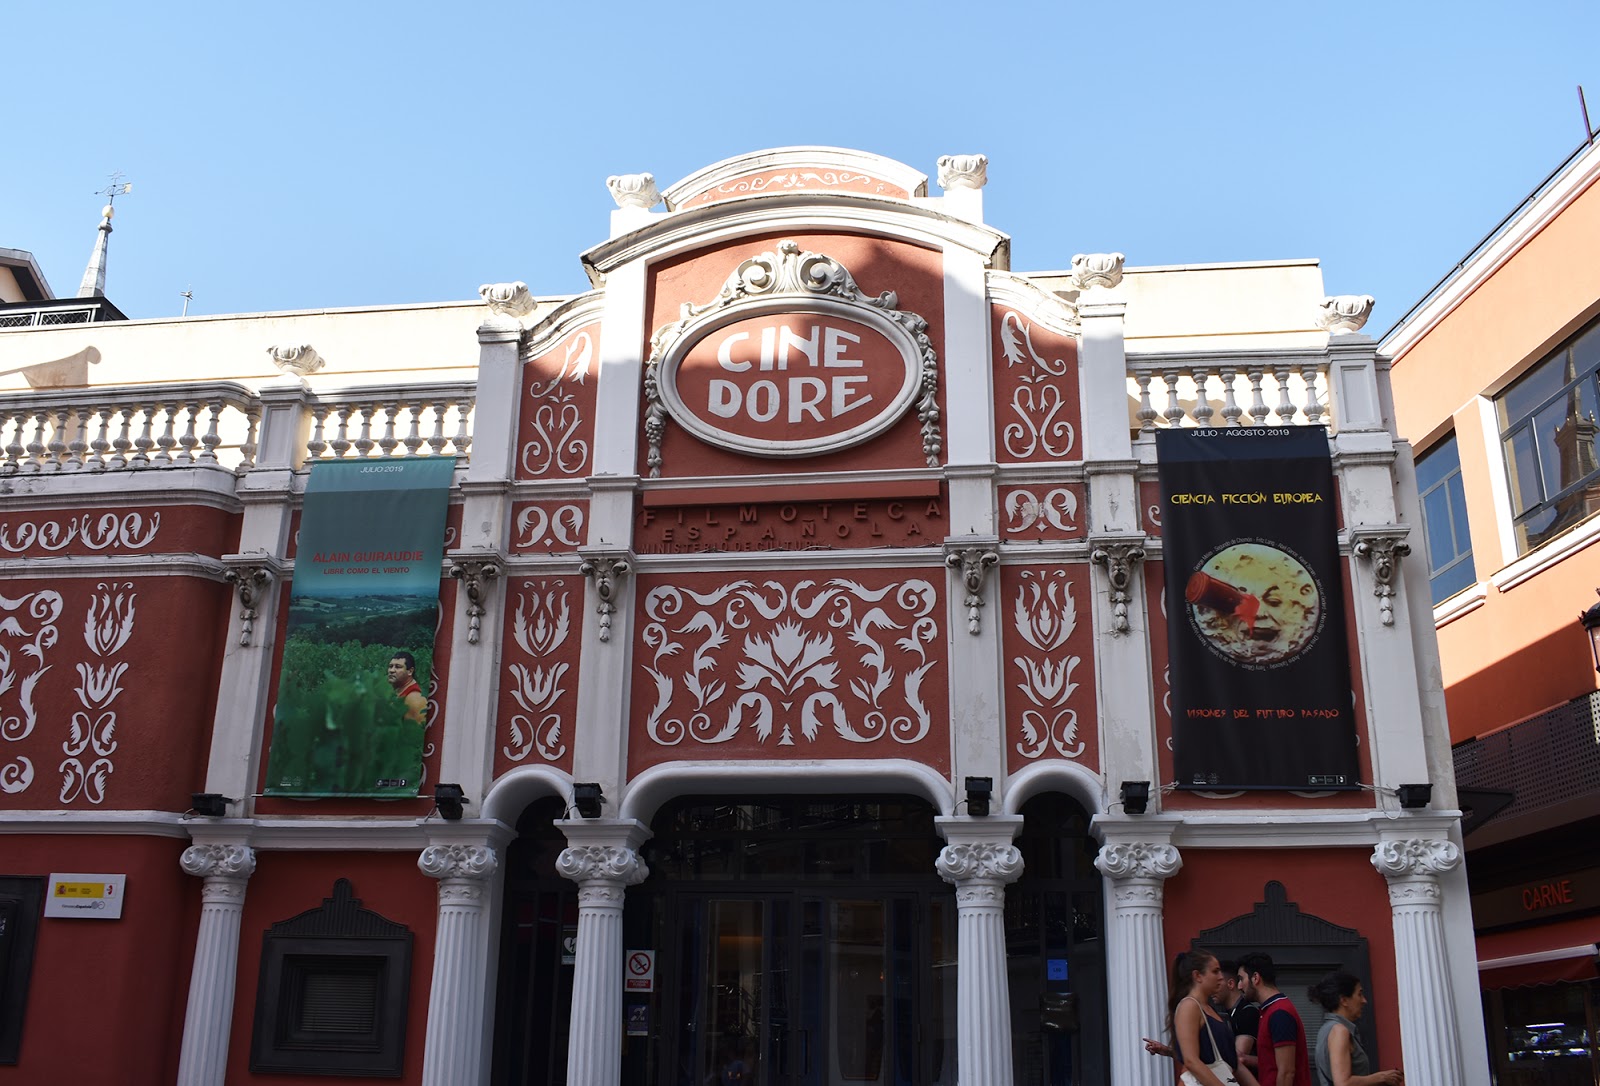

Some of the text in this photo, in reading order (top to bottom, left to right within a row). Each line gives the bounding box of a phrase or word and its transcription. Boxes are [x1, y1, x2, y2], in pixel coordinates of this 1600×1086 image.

[717, 325, 864, 373] CINE
[707, 375, 873, 424] DORE
[1191, 429, 1218, 437] JULIO
[1225, 429, 1266, 437] AGOSTO
[1267, 428, 1290, 436] 2019
[384, 465, 404, 473] 2019
[1171, 491, 1323, 505] CIENCIA FICCIÓN EUROPEA
[642, 500, 941, 527] FILMOTECA
[662, 518, 921, 542] ESPAÑOLA
[736, 541, 751, 552] DE
[312, 551, 424, 563] ALAIN GUIRAUDIE
[1187, 708, 1339, 719] VISIONES DEL FUTURO PASADO
[1522, 880, 1574, 911] CARNE
